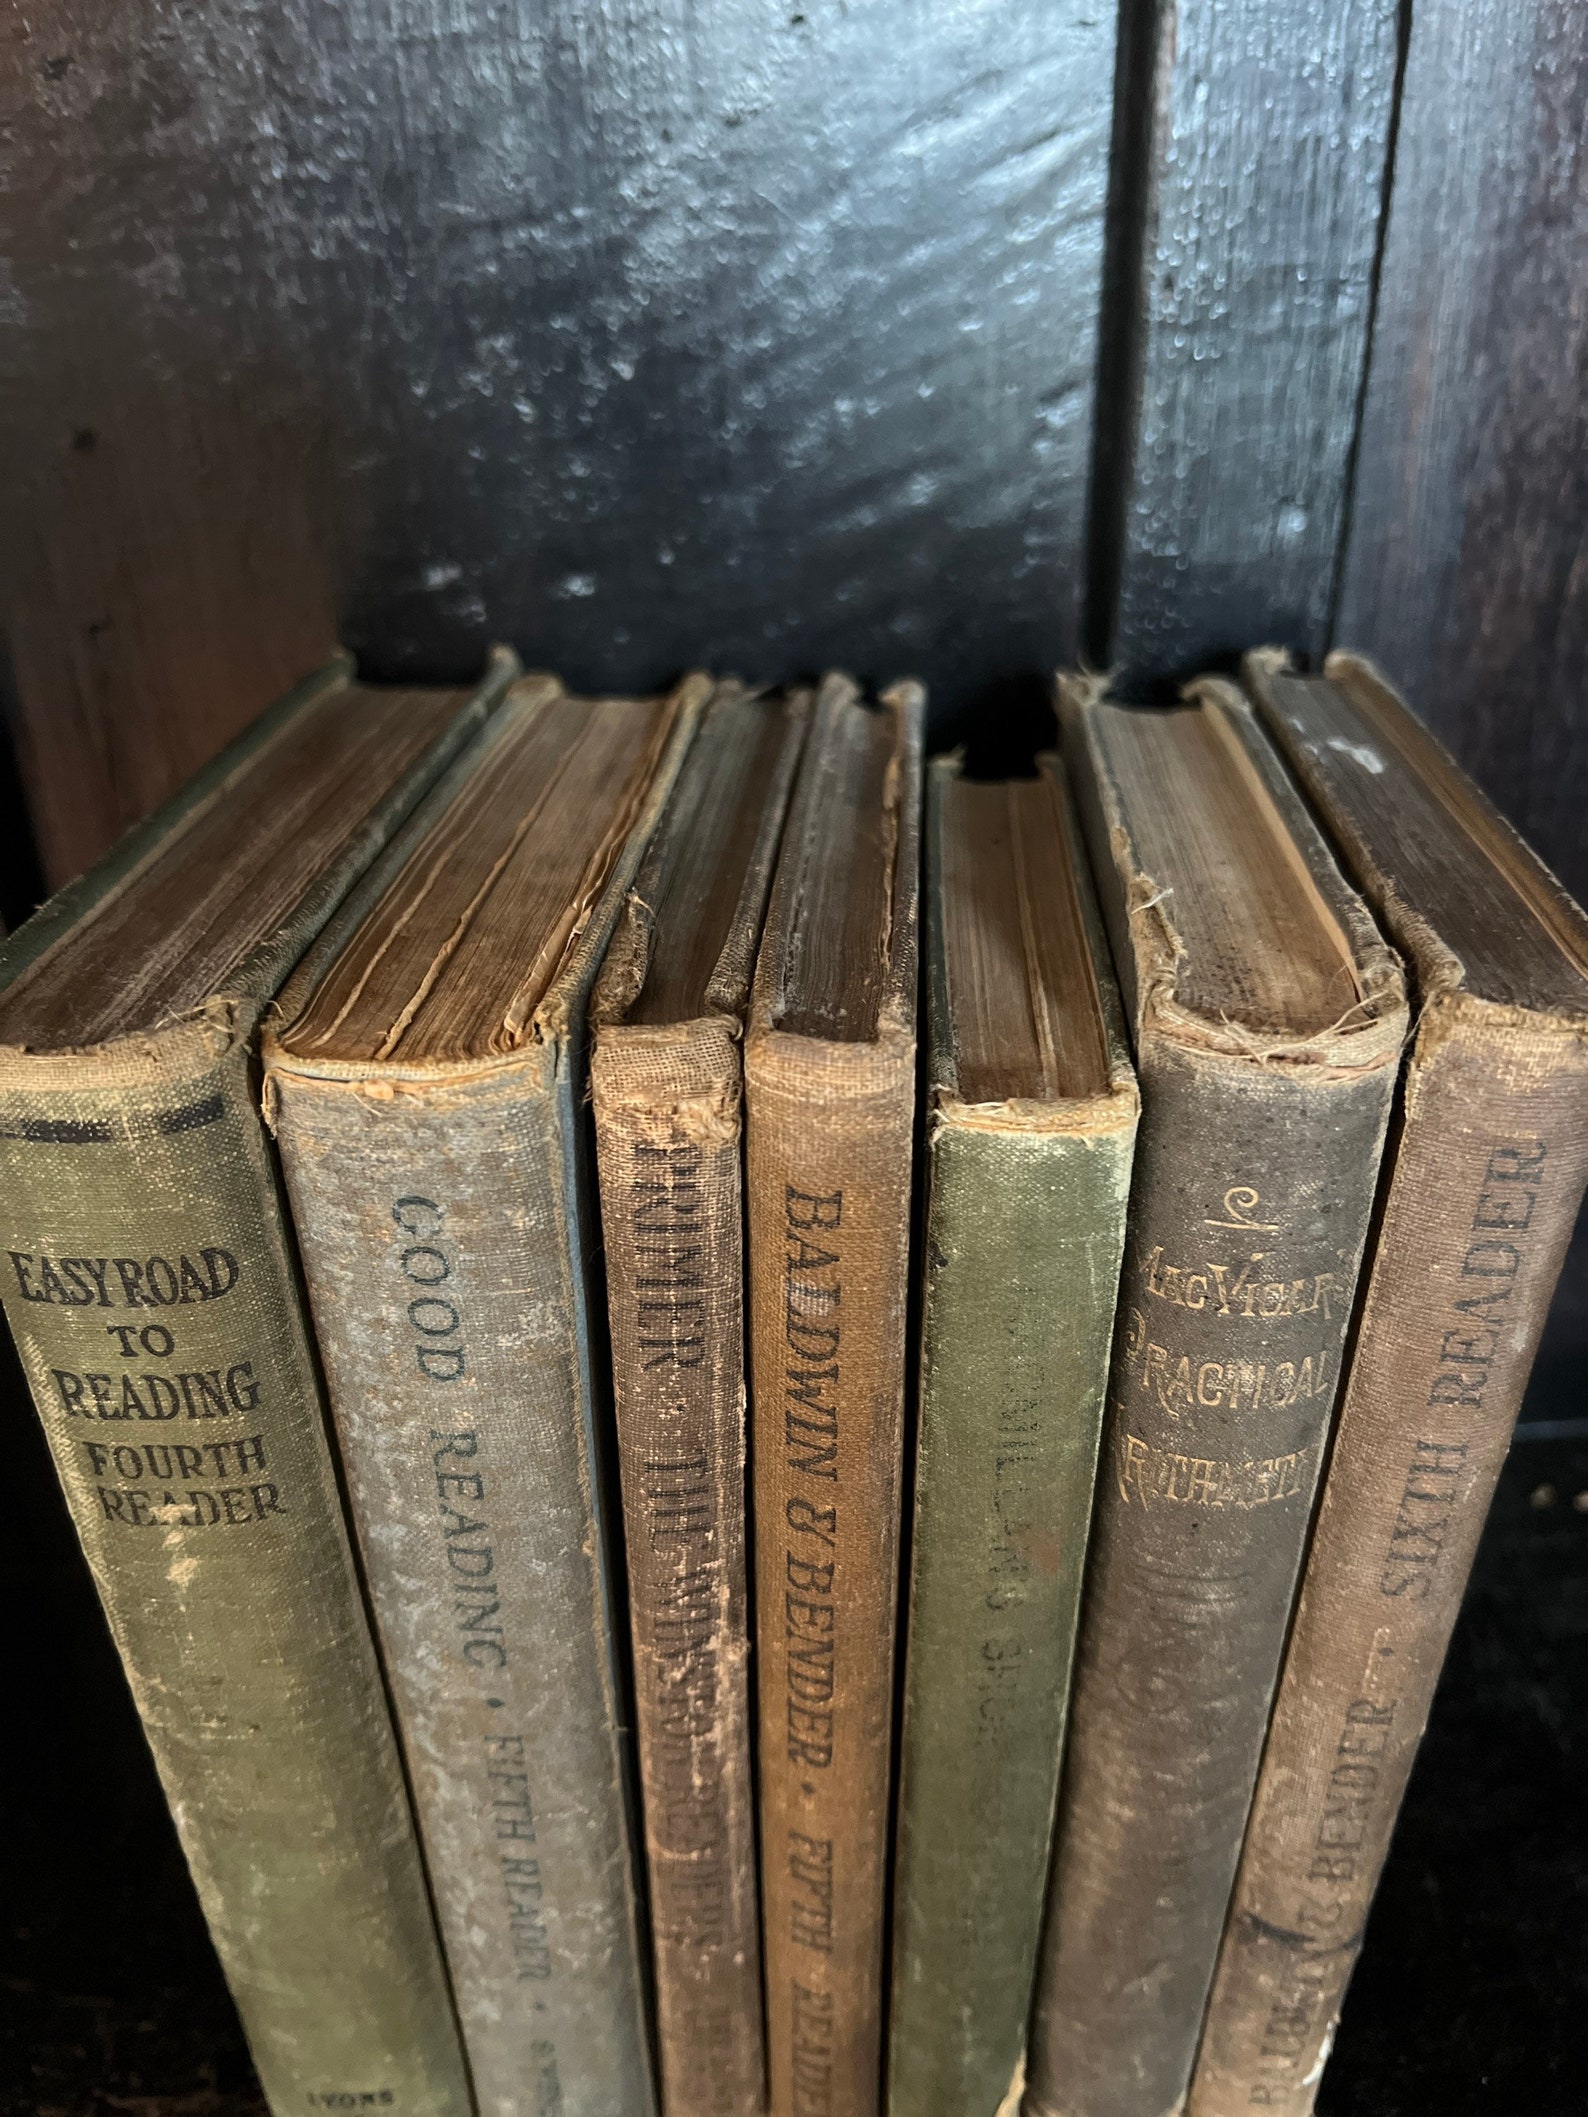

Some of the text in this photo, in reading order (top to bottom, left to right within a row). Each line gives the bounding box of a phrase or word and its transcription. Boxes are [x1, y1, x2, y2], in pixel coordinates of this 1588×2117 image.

[8, 1247, 240, 1308] EASY ROAD
[392, 1196, 466, 1383] GOOD
[632, 1142, 706, 1373] PRIMER
[51, 1361, 263, 1421] READING
[106, 1323, 175, 1358] TO
[785, 1185, 843, 1482] BALDWIN
[83, 1435, 267, 1480] FOURTH
[96, 1483, 288, 1527] READER
[644, 1449, 714, 1553] THE
[1308, 1698, 1400, 1883] BENDER
[1380, 1440, 1468, 1598] SIXTH
[1426, 1142, 1548, 1409] READER
[429, 1428, 508, 1669] READING
[786, 1495, 836, 1547] &
[785, 1551, 834, 1768] BENDER
[484, 1735, 537, 1843] FIFTH
[501, 1857, 553, 1982] READER
[788, 1829, 834, 1954] FIFTH
